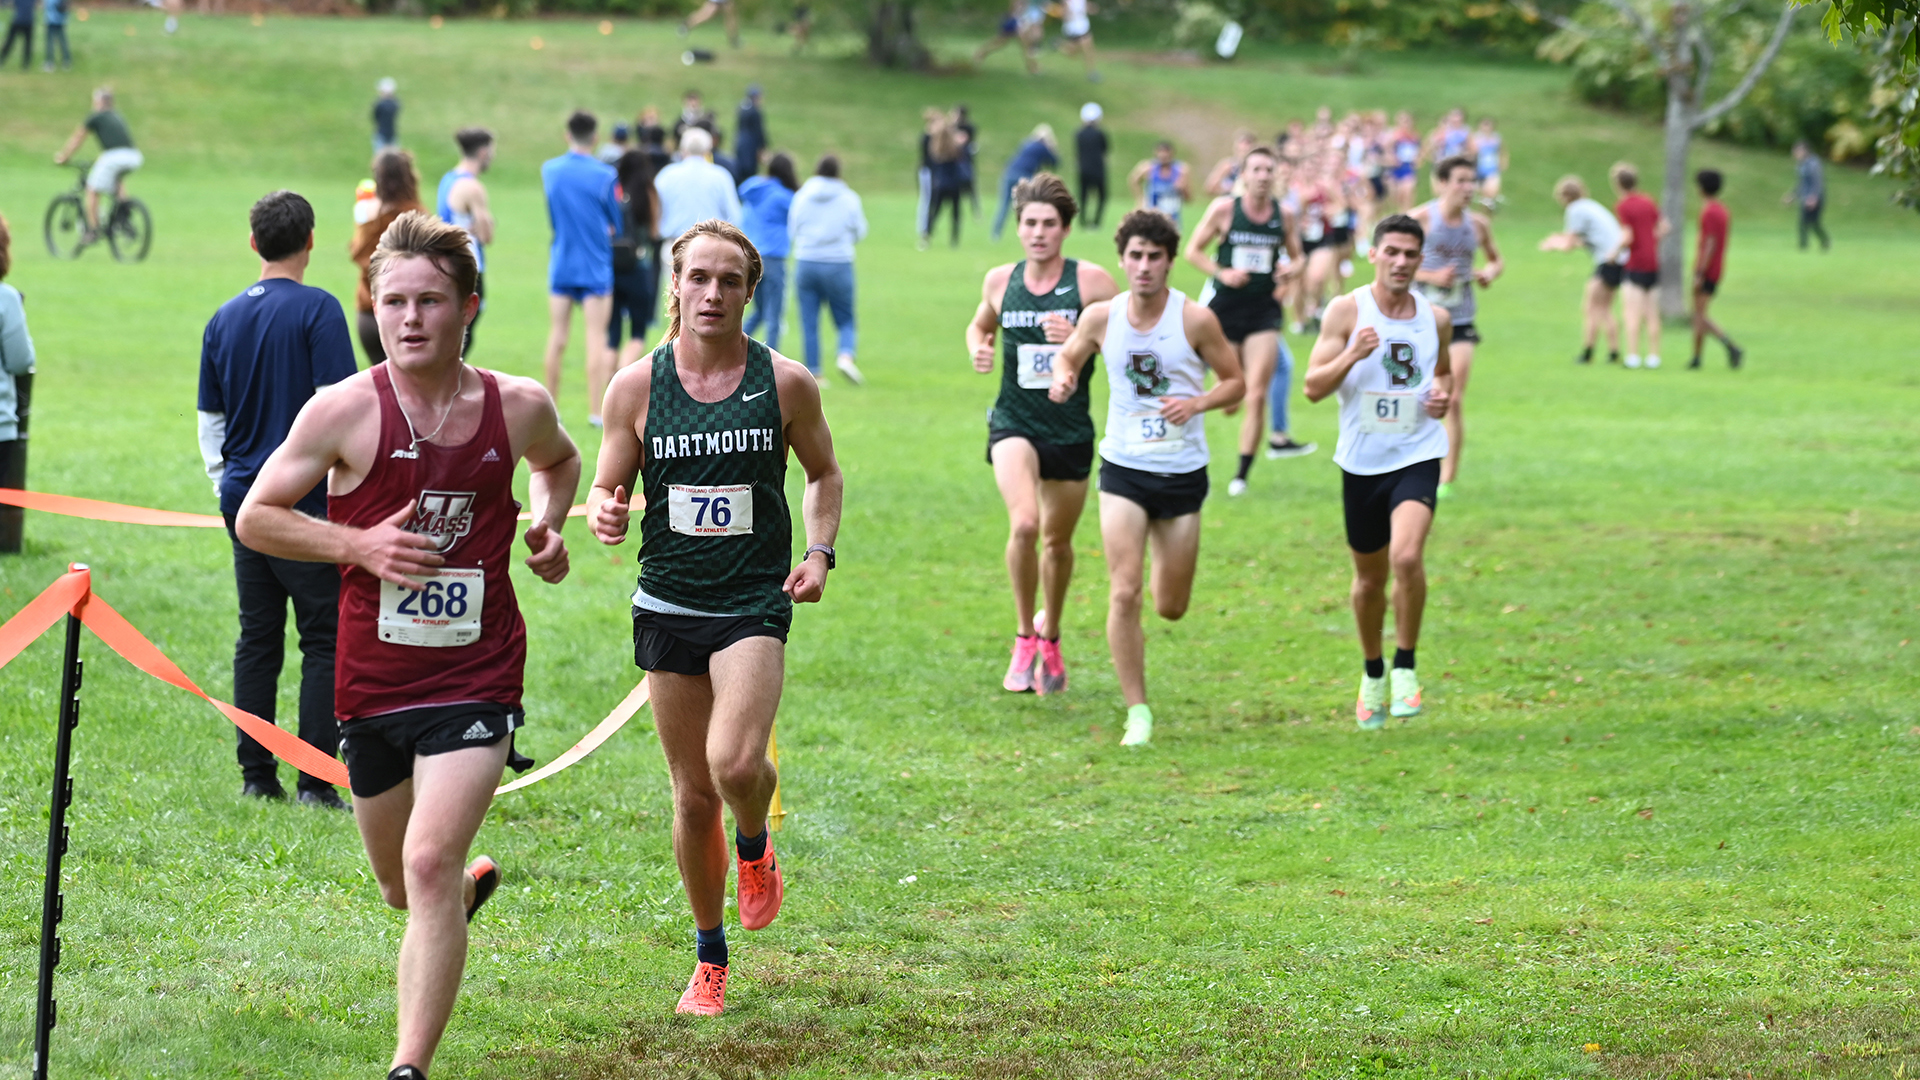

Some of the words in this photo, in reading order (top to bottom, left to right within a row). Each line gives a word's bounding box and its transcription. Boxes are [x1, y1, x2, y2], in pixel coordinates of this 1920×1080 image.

[1376, 398, 1400, 419] 61
[1142, 417, 1167, 438] 53
[652, 428, 774, 460] DARTMOUTH
[708, 486, 747, 494] CHAMPIONSHIPS
[691, 497, 731, 527] 76
[396, 580, 468, 619] 268
[462, 731, 494, 740] adidas
